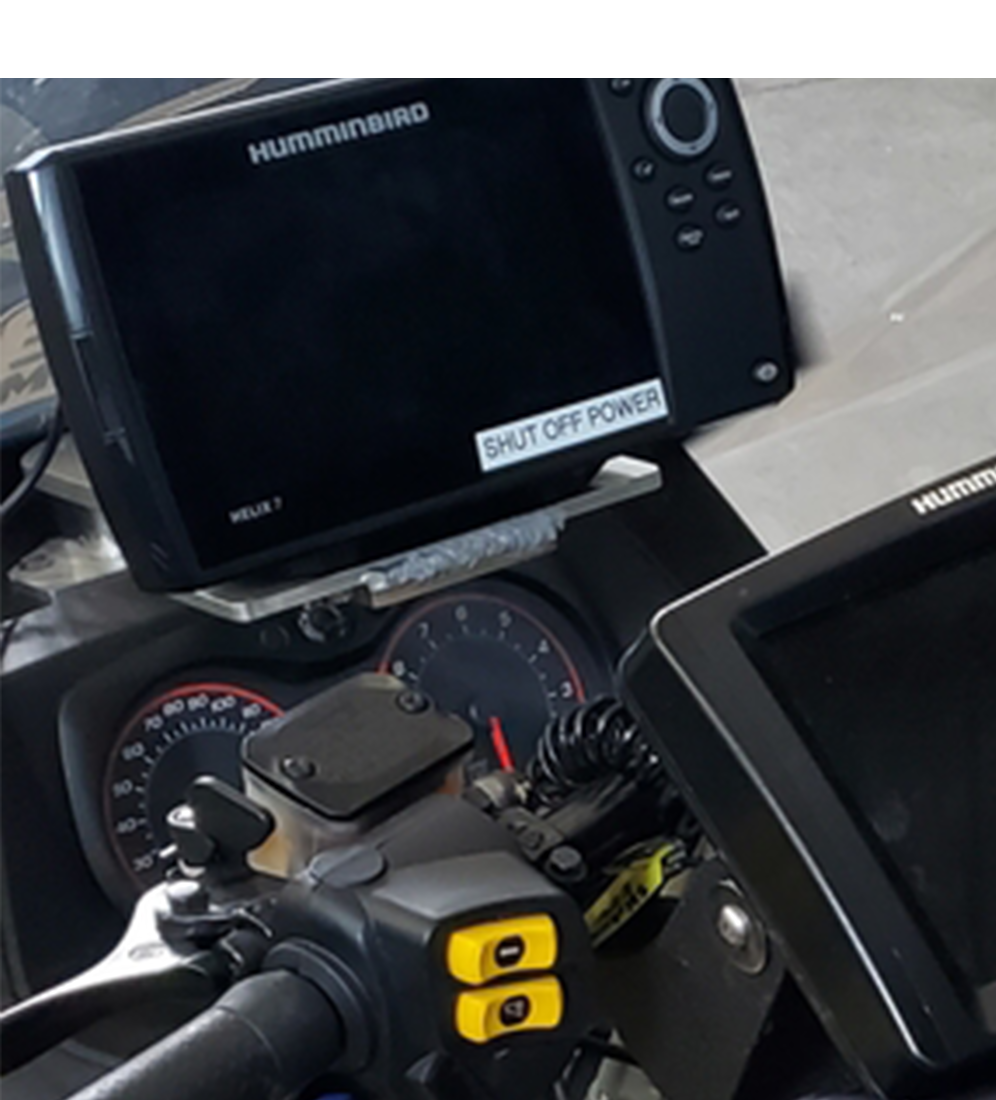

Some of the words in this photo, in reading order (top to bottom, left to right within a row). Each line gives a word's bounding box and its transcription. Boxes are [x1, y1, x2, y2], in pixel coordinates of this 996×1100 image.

[249, 102, 430, 164] HUMMINBIRD
[483, 425, 537, 460] SHUT
[542, 411, 584, 441] OFF
[587, 387, 661, 428] POWER
